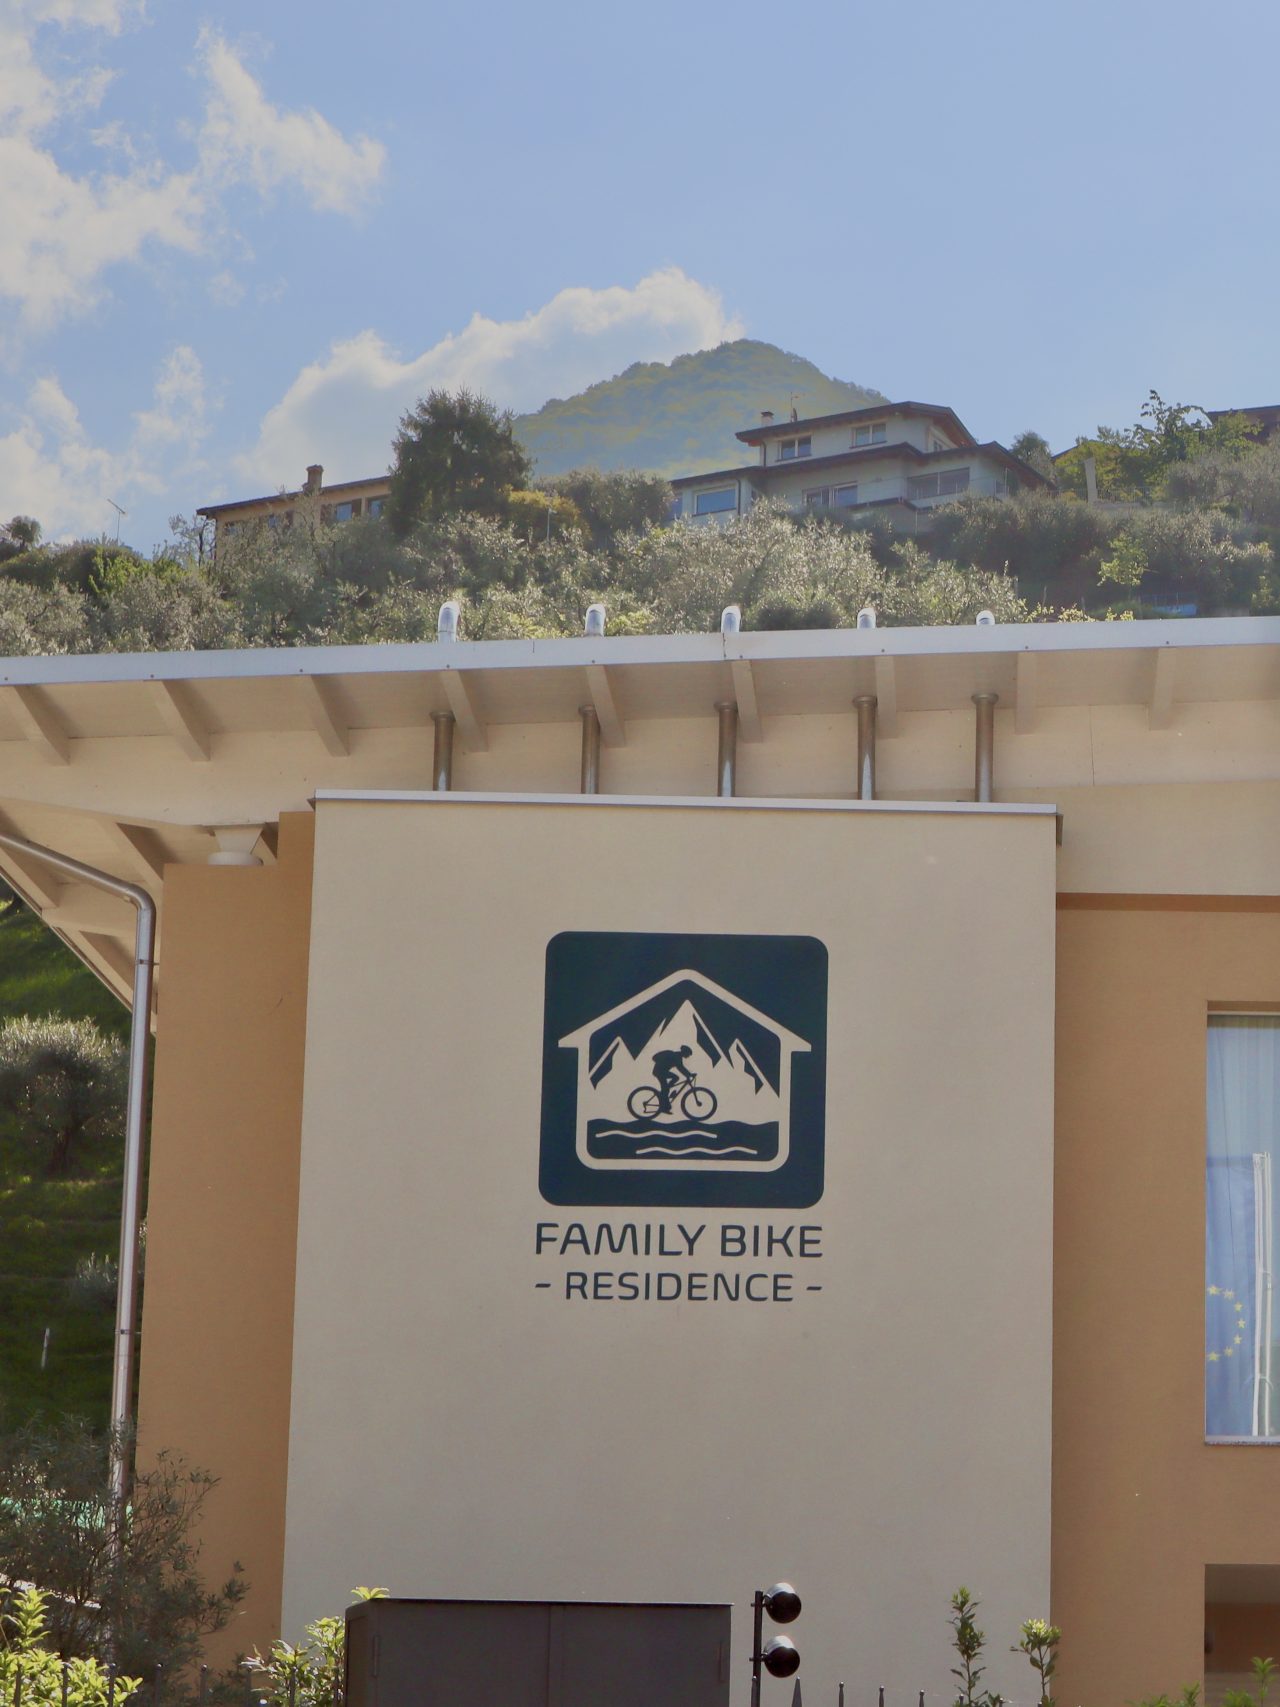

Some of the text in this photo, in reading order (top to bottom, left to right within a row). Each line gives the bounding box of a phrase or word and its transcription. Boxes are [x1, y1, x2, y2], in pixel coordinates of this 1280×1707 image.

[534, 1222, 825, 1259] FAMILY BIKE
[565, 1271, 795, 1303] RESIDENCE
